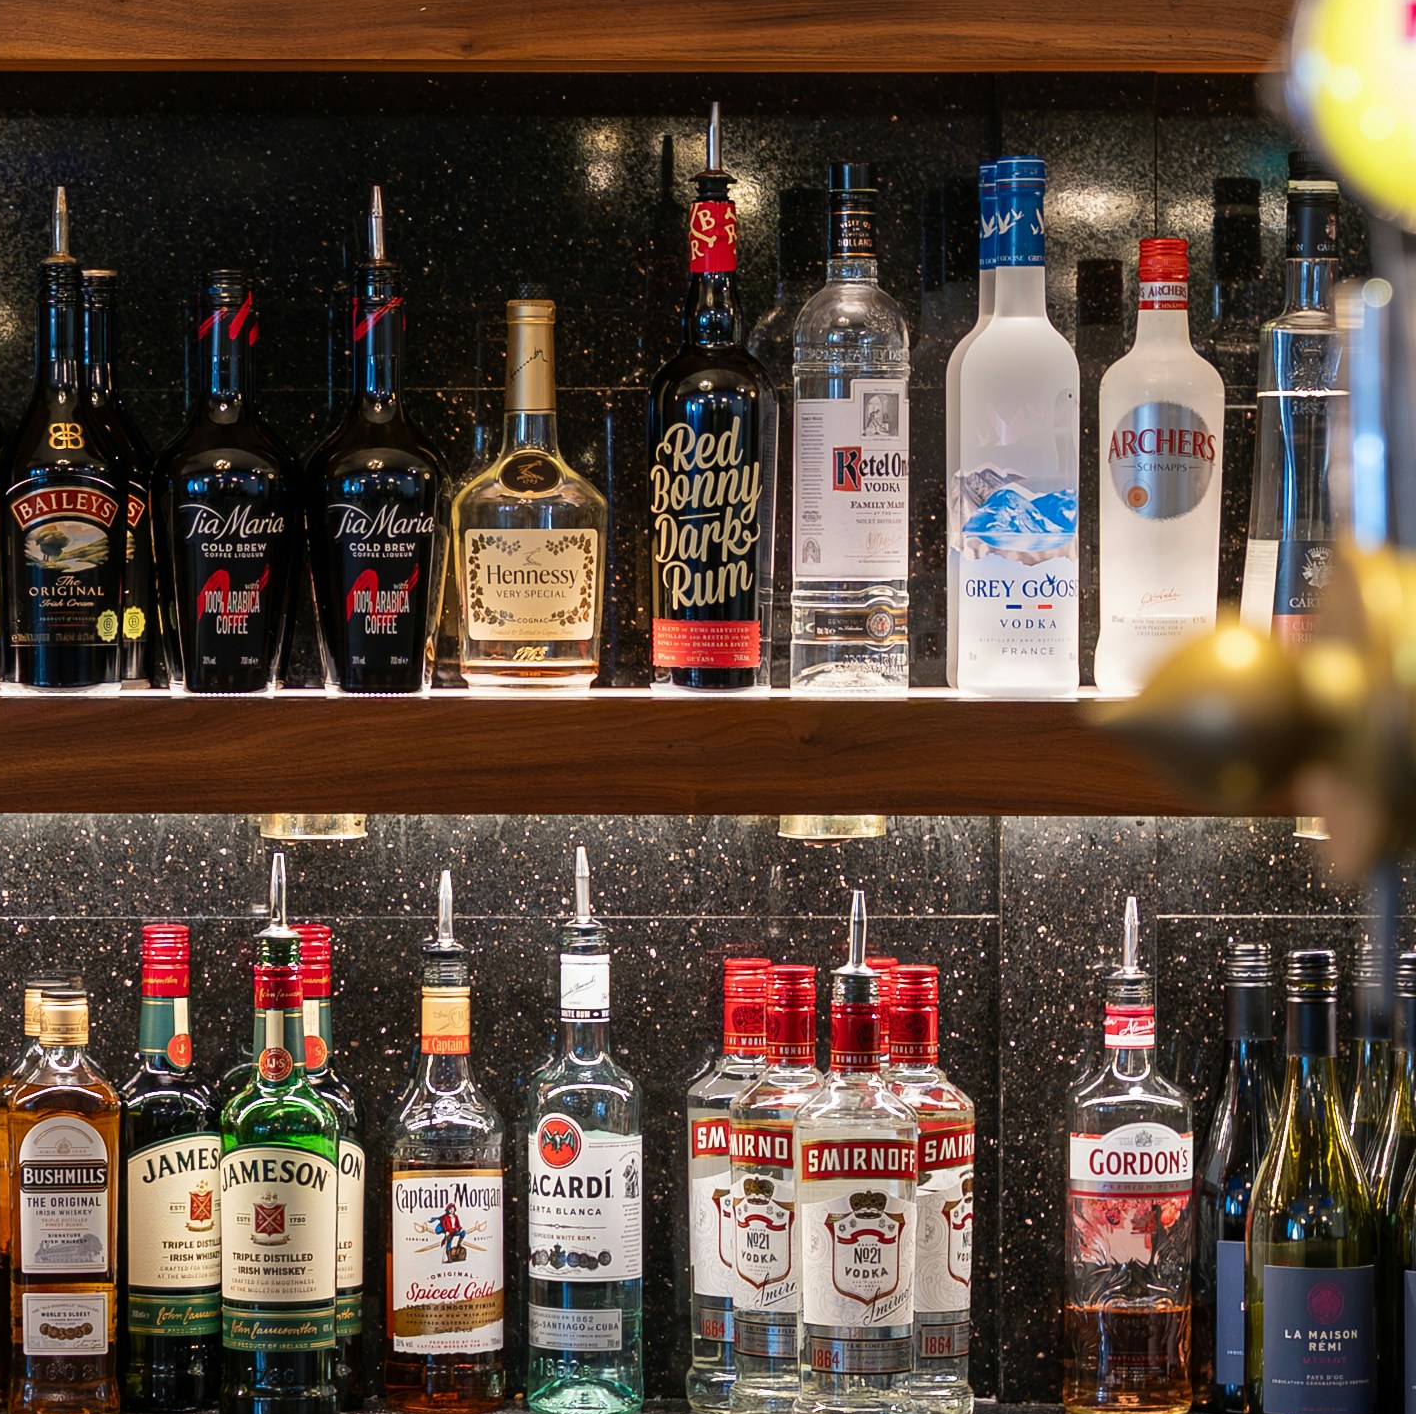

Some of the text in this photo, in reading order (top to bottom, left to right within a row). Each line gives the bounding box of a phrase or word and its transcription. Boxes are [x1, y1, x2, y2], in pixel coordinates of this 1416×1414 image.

[656, 416, 743, 471] Red
[1108, 428, 1216, 464] ARCHERS
[834, 450, 908, 489] Ketel On
[1137, 462, 1188, 472] SCHNAPPS
[651, 461, 762, 524] Bonny
[864, 482, 900, 492] VODKA
[19, 493, 111, 518] BAILEYS
[179, 504, 284, 539] Tia Maria
[328, 504, 434, 539] Tia Maria
[201, 543, 267, 552] COLD BREW
[349, 543, 416, 552] COLD BREW
[655, 514, 760, 563] Dark
[487, 565, 579, 588] Hennessy
[663, 560, 753, 611] Rum
[29, 586, 104, 596] ORIGINAL
[496, 590, 566, 598] VERY SPECIAL
[966, 579, 1015, 598] GREY
[204, 591, 260, 613] 100% ARABICA
[353, 591, 409, 613] 100% ARABICA
[216, 616, 248, 634] COFFEE
[365, 616, 397, 634] COFFEE
[1000, 619, 1056, 628] VODKA
[1002, 647, 1055, 655] FRANCE
[142, 1148, 221, 1184] JAMES
[808, 1148, 915, 1172] SMIRNOFF
[1089, 1147, 1188, 1175] GORDON'S
[23, 1167, 105, 1185] BUSHMILLS
[222, 1159, 327, 1192] JAMESON
[27, 1196, 101, 1207] THE ORIGINAL
[396, 1183, 501, 1213] Captain Morgan
[556, 1208, 602, 1216] BLANCA
[232, 1252, 313, 1263] TRIPLE DISTILLED
[741, 1252, 778, 1263] VODKA
[237, 1267, 306, 1276] IRISH WHISKEY
[430, 1271, 474, 1279] ORIGINAL
[845, 1267, 889, 1278] VODKA
[406, 1280, 495, 1302] Spiced Gold
[542, 1321, 619, 1331] SANTIAGO CUBA
[701, 1318, 726, 1339] 1864
[1285, 1329, 1358, 1339] LA MAISON
[1308, 1339, 1342, 1352] RÉMI
[813, 1348, 840, 1369] 1864
